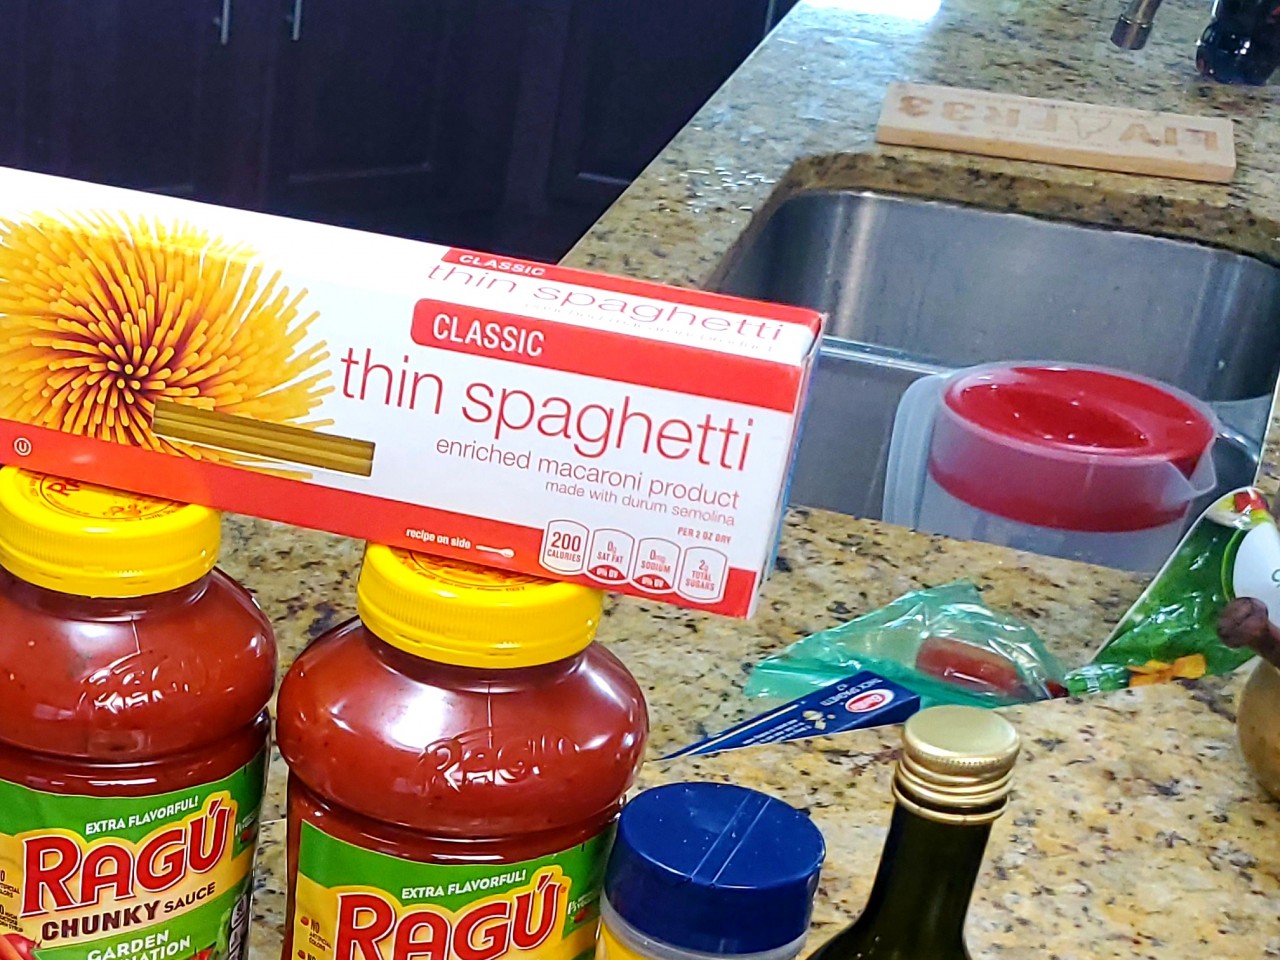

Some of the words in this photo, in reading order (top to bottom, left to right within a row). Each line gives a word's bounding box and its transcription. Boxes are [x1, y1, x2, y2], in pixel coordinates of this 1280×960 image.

[458, 253, 548, 277] CLASSIC
[426, 264, 518, 295] thin
[533, 283, 786, 343] spaghetti
[432, 312, 545, 358] CLASSIC
[340, 347, 444, 415] thin
[460, 380, 756, 473] spaghetti
[436, 436, 532, 472] enriched
[537, 456, 644, 494] macaroni
[648, 476, 741, 511] product
[544, 479, 586, 498] made
[589, 485, 618, 504] with
[622, 493, 668, 514] durum
[671, 504, 736, 528] semolina
[405, 527, 436, 544] recipe
[437, 534, 450, 545] on
[451, 533, 472, 550] side
[550, 531, 582, 553] 200
[677, 526, 695, 538] PER
[703, 531, 714, 543] OZ
[715, 534, 733, 545] DRY
[546, 548, 582, 564] CALORIES
[596, 551, 611, 563] SAT
[611, 553, 625, 566] FAT
[640, 560, 672, 575] SODIUM
[685, 578, 716, 593] SUGARS
[691, 569, 713, 582] TOTAL
[85, 816, 126, 836] EXTRA
[128, 795, 199, 827] FLAVORFUL!
[401, 879, 445, 900] EXTRA
[447, 869, 527, 898] FLAVORFUL!
[41, 900, 161, 941] CHUNKY
[164, 881, 217, 914] SAUCE
[311, 918, 320, 934] NO
